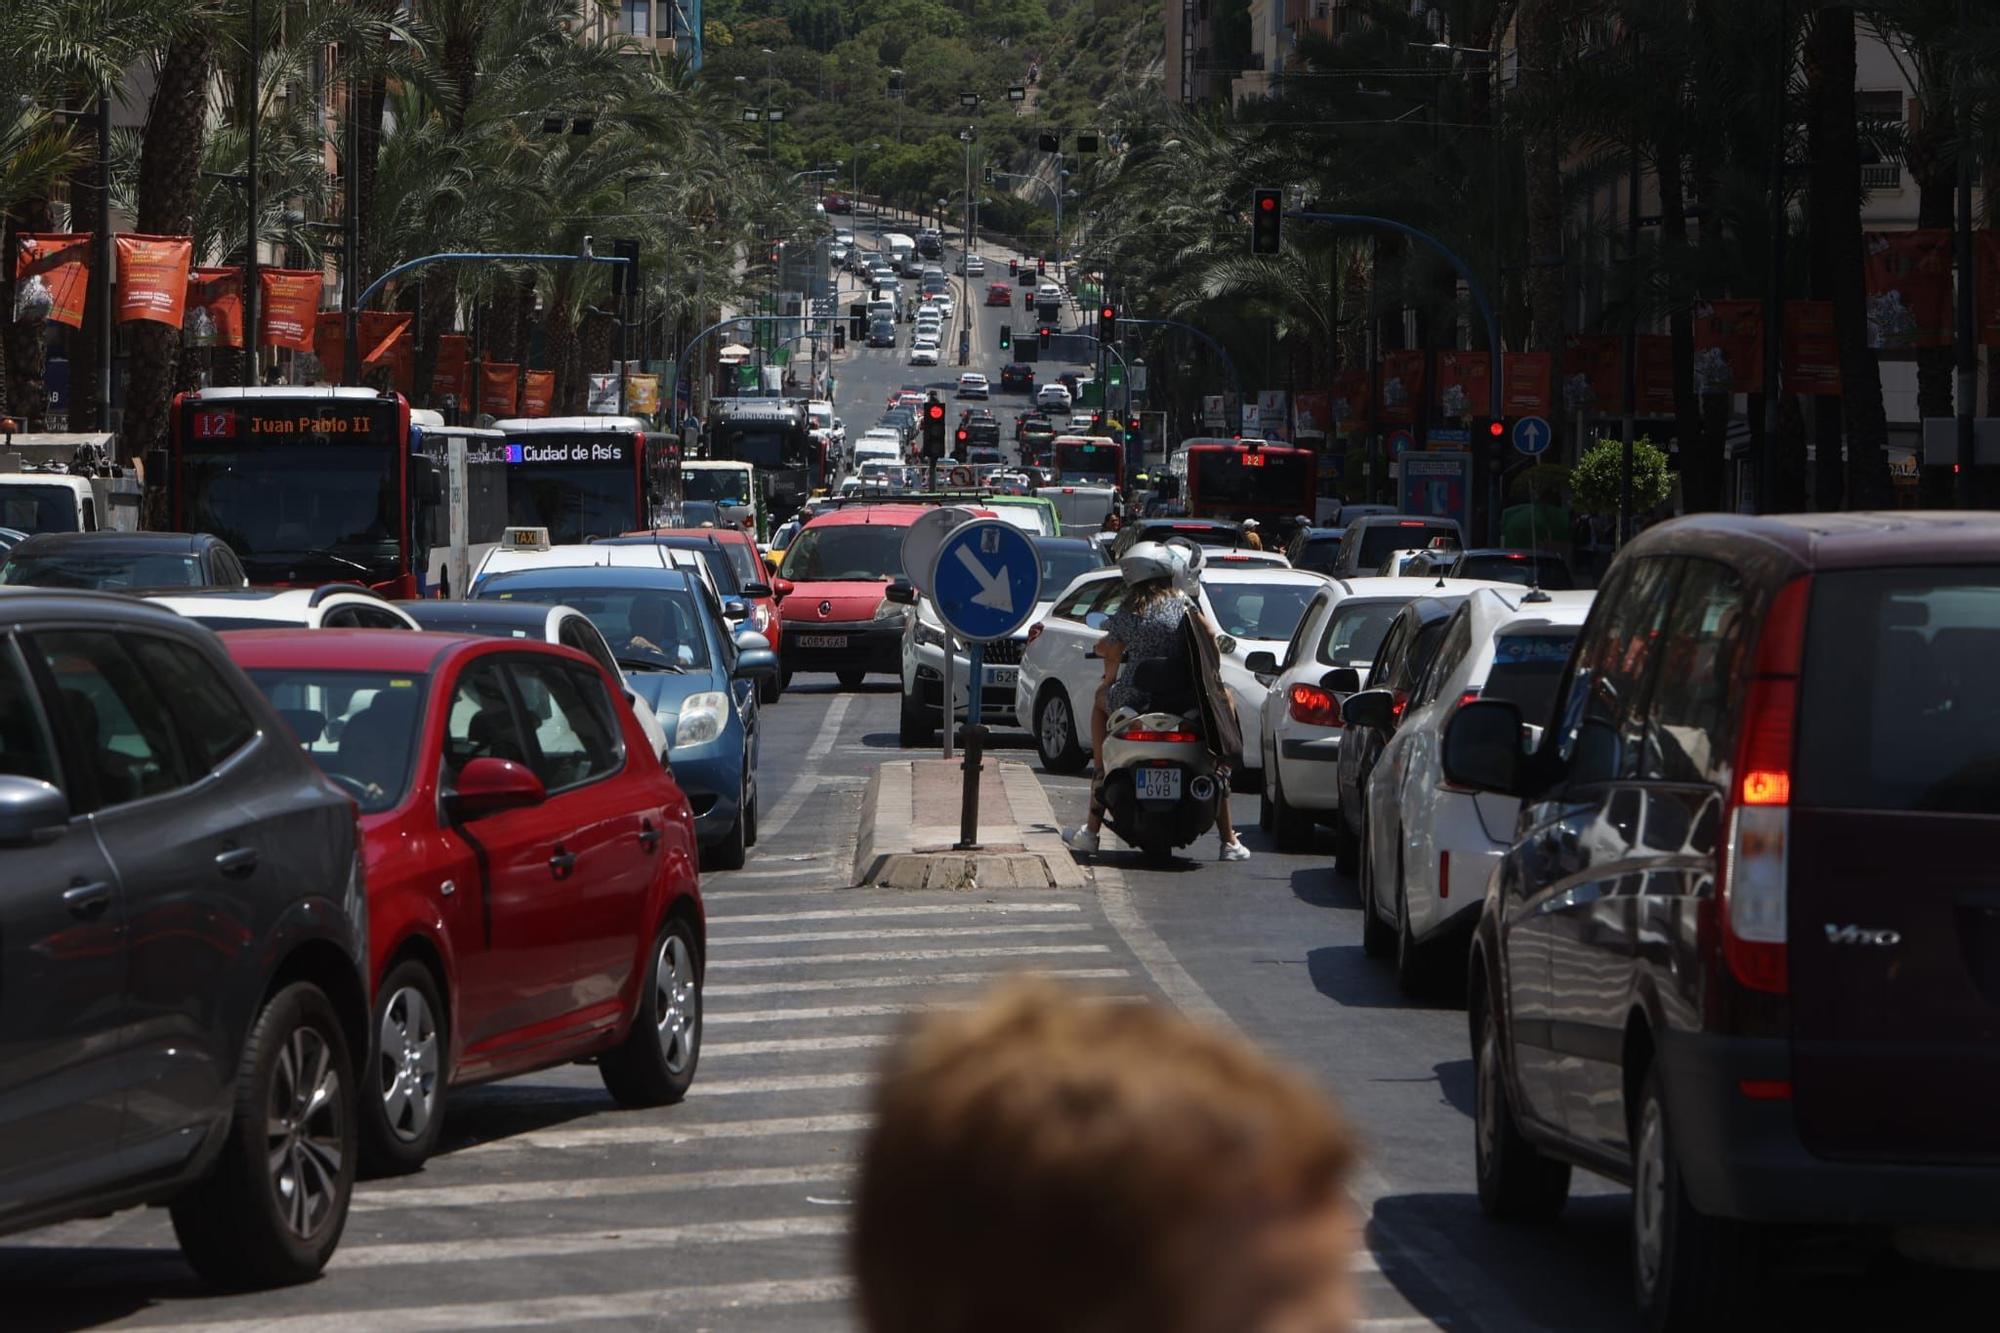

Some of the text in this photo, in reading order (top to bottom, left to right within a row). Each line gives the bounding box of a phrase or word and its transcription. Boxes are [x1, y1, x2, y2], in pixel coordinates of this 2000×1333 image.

[202, 415, 226, 435] 12
[251, 416, 371, 433] Juan Pablo II
[523, 444, 568, 461] Ciudad
[571, 444, 588, 460] de
[592, 443, 621, 460] Asís
[1247, 455, 1259, 466] 22
[515, 531, 536, 544] TAXI
[1147, 770, 1178, 783] 1784
